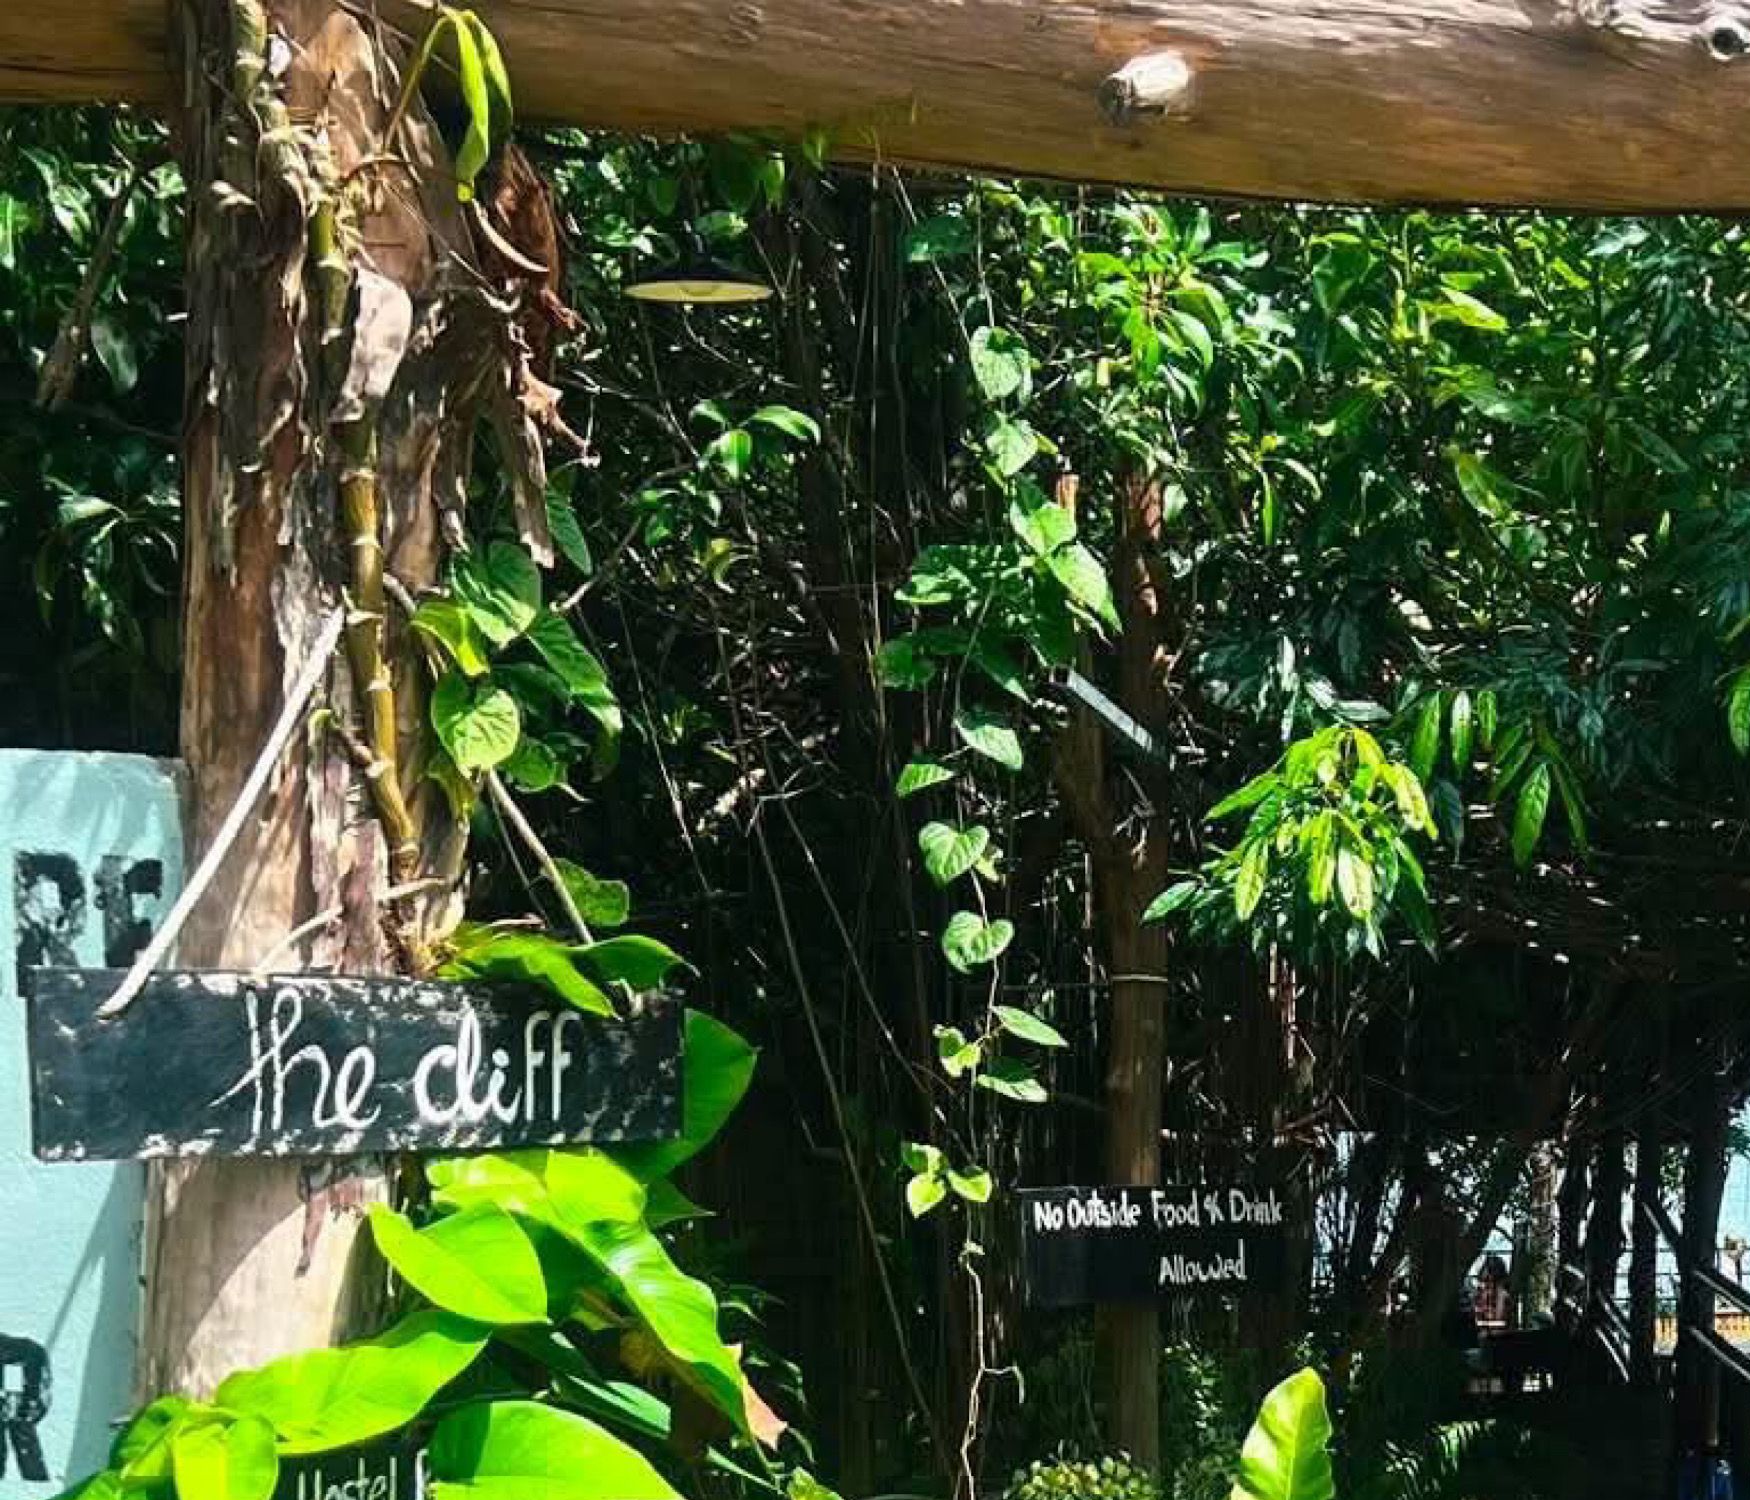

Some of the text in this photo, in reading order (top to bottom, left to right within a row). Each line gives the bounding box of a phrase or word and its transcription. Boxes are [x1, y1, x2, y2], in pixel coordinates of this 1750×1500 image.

[208, 985, 381, 1138] the
[1034, 1200, 1063, 1232] No
[1066, 1190, 1141, 1229] Outside
[1150, 1188, 1200, 1229] Food
[1229, 1188, 1283, 1226] Drink
[1159, 1238, 1247, 1286] Allowed
